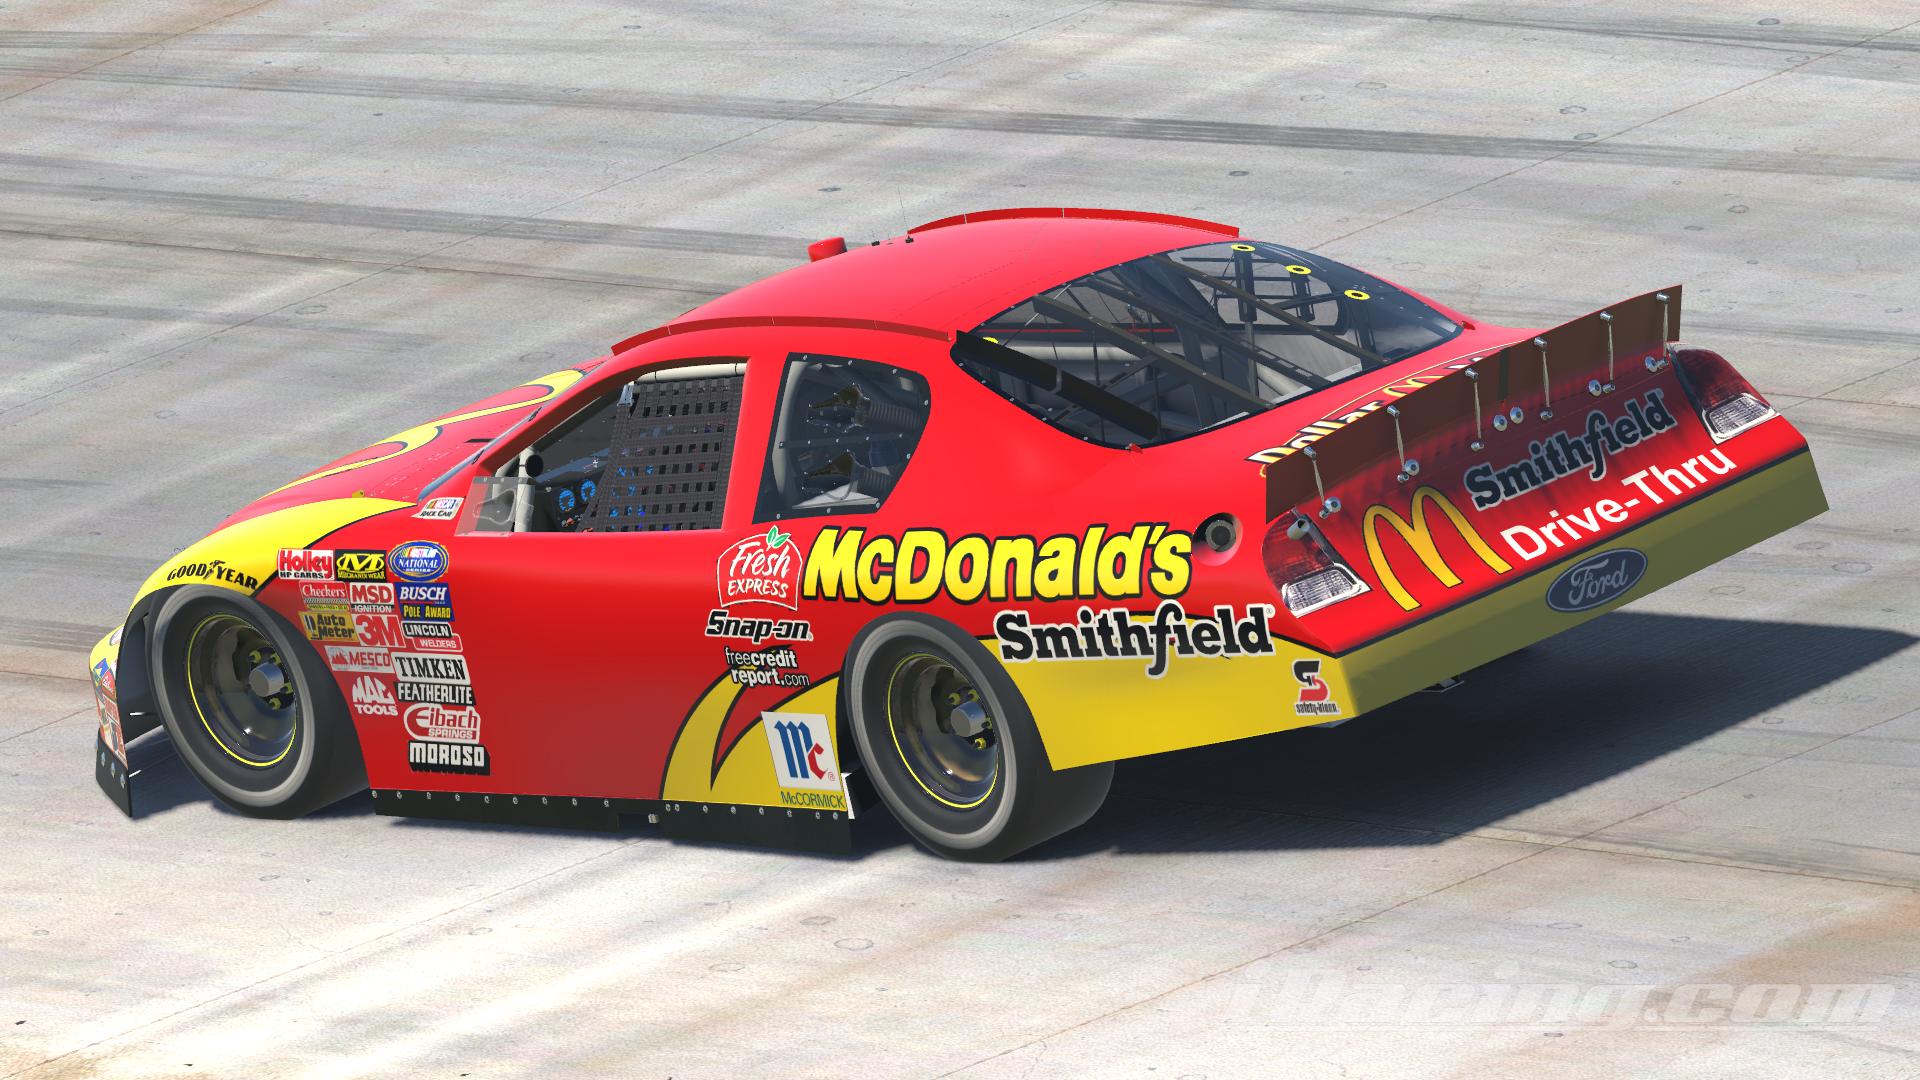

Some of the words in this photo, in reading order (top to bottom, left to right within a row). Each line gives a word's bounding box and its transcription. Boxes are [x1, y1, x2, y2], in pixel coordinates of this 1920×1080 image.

[1464, 388, 1678, 510] Smithfield
[1500, 447, 1737, 561] Drive-Thru
[279, 549, 333, 579] Holley
[398, 558, 439, 569] NATIONAL
[729, 541, 792, 579] Fresh
[802, 525, 1193, 604] McDonald's
[293, 571, 324, 579] CARBS
[1568, 557, 1629, 607] Ford
[302, 584, 346, 598] Checkers
[351, 584, 393, 604] MSD
[400, 586, 447, 601] BUSCH
[727, 577, 790, 599] EXPRESS
[353, 604, 393, 614] IGNITION
[403, 605, 421, 618] POLE
[424, 605, 451, 619] AWARD
[316, 614, 346, 627] Auto
[405, 624, 450, 637] LINCOLN
[706, 610, 811, 643] Snap-on
[318, 626, 354, 640] Meter
[355, 614, 402, 648] 3M
[995, 600, 1275, 678] Smithfield
[419, 638, 457, 648] WELDERS
[350, 651, 391, 667] MESCO
[725, 647, 798, 668] freecredit
[395, 656, 466, 681] TIMKEN
[731, 668, 810, 687] report.com
[352, 675, 396, 704] MAC
[398, 682, 473, 705] FEATHERLITE
[354, 704, 398, 716] TOOLS
[407, 704, 478, 739] Eibach
[428, 728, 473, 739] SPRINGS
[409, 742, 486, 768] MOROSO
[780, 791, 845, 808] McCORMICK
